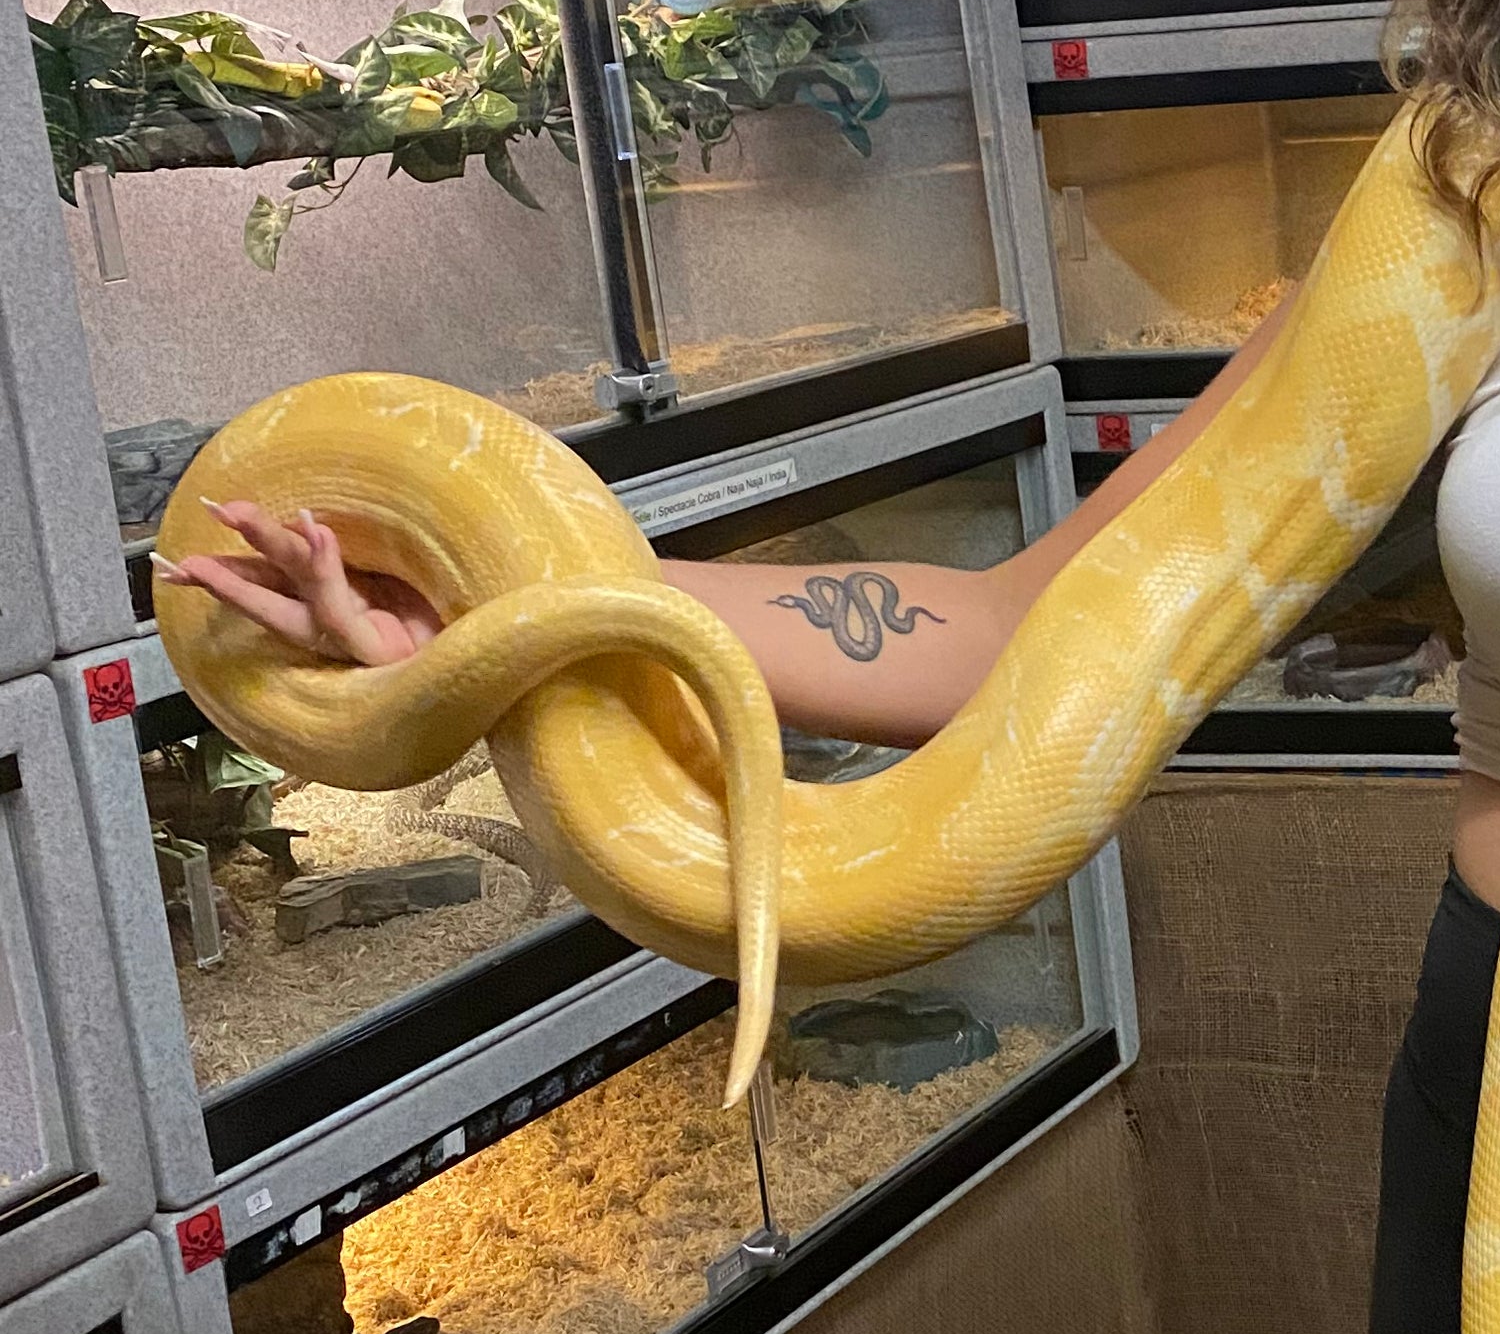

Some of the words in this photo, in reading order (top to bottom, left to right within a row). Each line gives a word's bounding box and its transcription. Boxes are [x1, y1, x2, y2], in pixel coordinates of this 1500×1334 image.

[697, 490, 721, 505] Cobra
[727, 483, 745, 497] Naja
[746, 477, 763, 491] Naja
[769, 469, 787, 482] India
